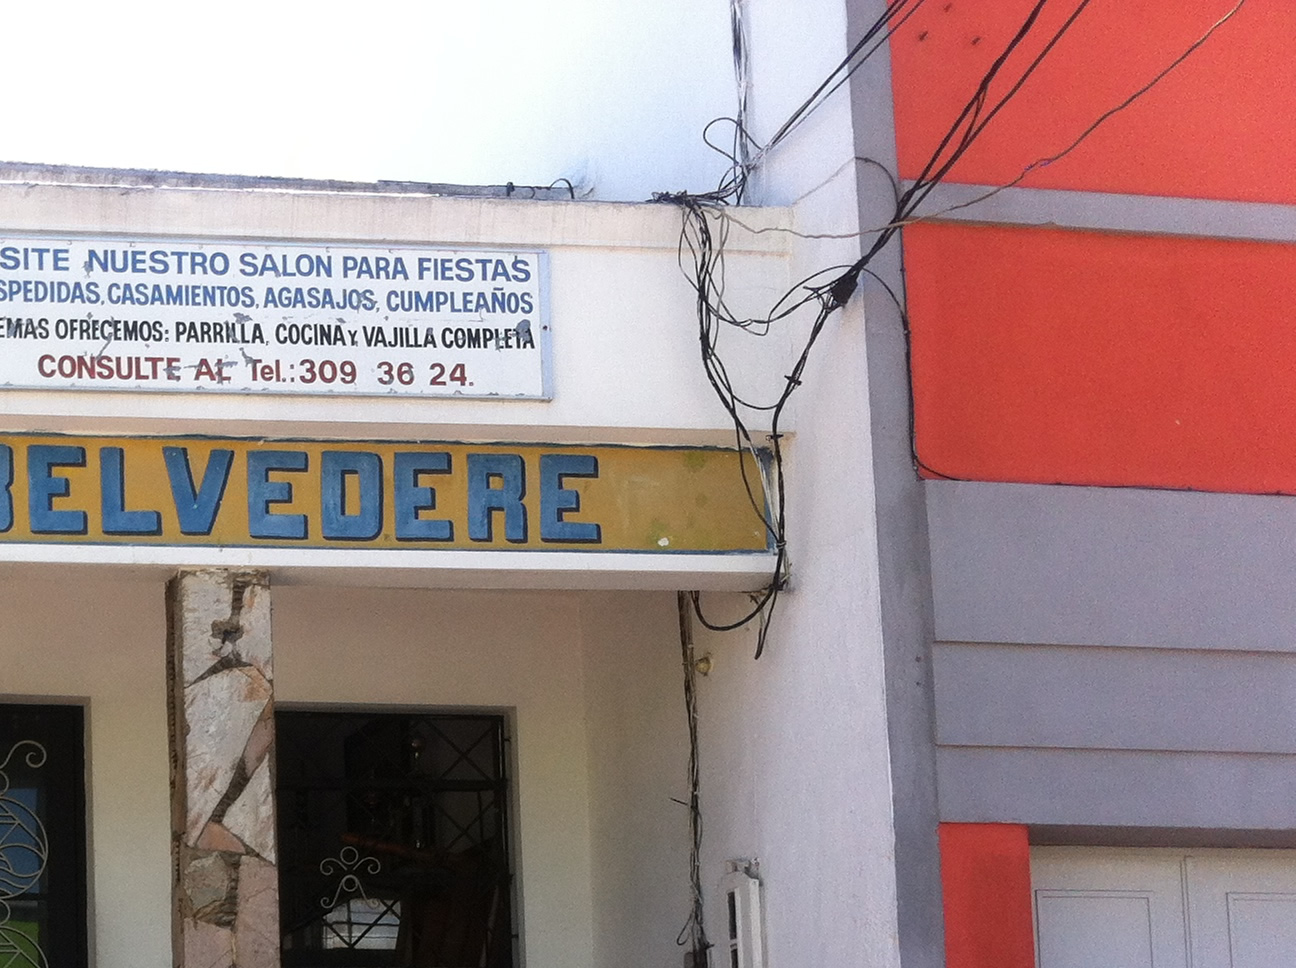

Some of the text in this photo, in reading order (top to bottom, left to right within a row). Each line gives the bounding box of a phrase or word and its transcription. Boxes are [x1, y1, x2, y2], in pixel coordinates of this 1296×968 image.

[87, 249, 230, 276] NUESTRO
[239, 252, 332, 278] SALON
[342, 256, 409, 281] PARA
[417, 257, 532, 283] FIESTAS
[386, 287, 534, 314] CUMPLEAÑOS
[54, 318, 170, 342] OFRECEMOS:
[274, 323, 347, 346] COCINA
[362, 326, 437, 349] VAJILLA
[441, 327, 536, 350] COMPLETA
[38, 354, 182, 380] CONSULTE
[193, 358, 232, 382] AL
[376, 361, 415, 385] 36
